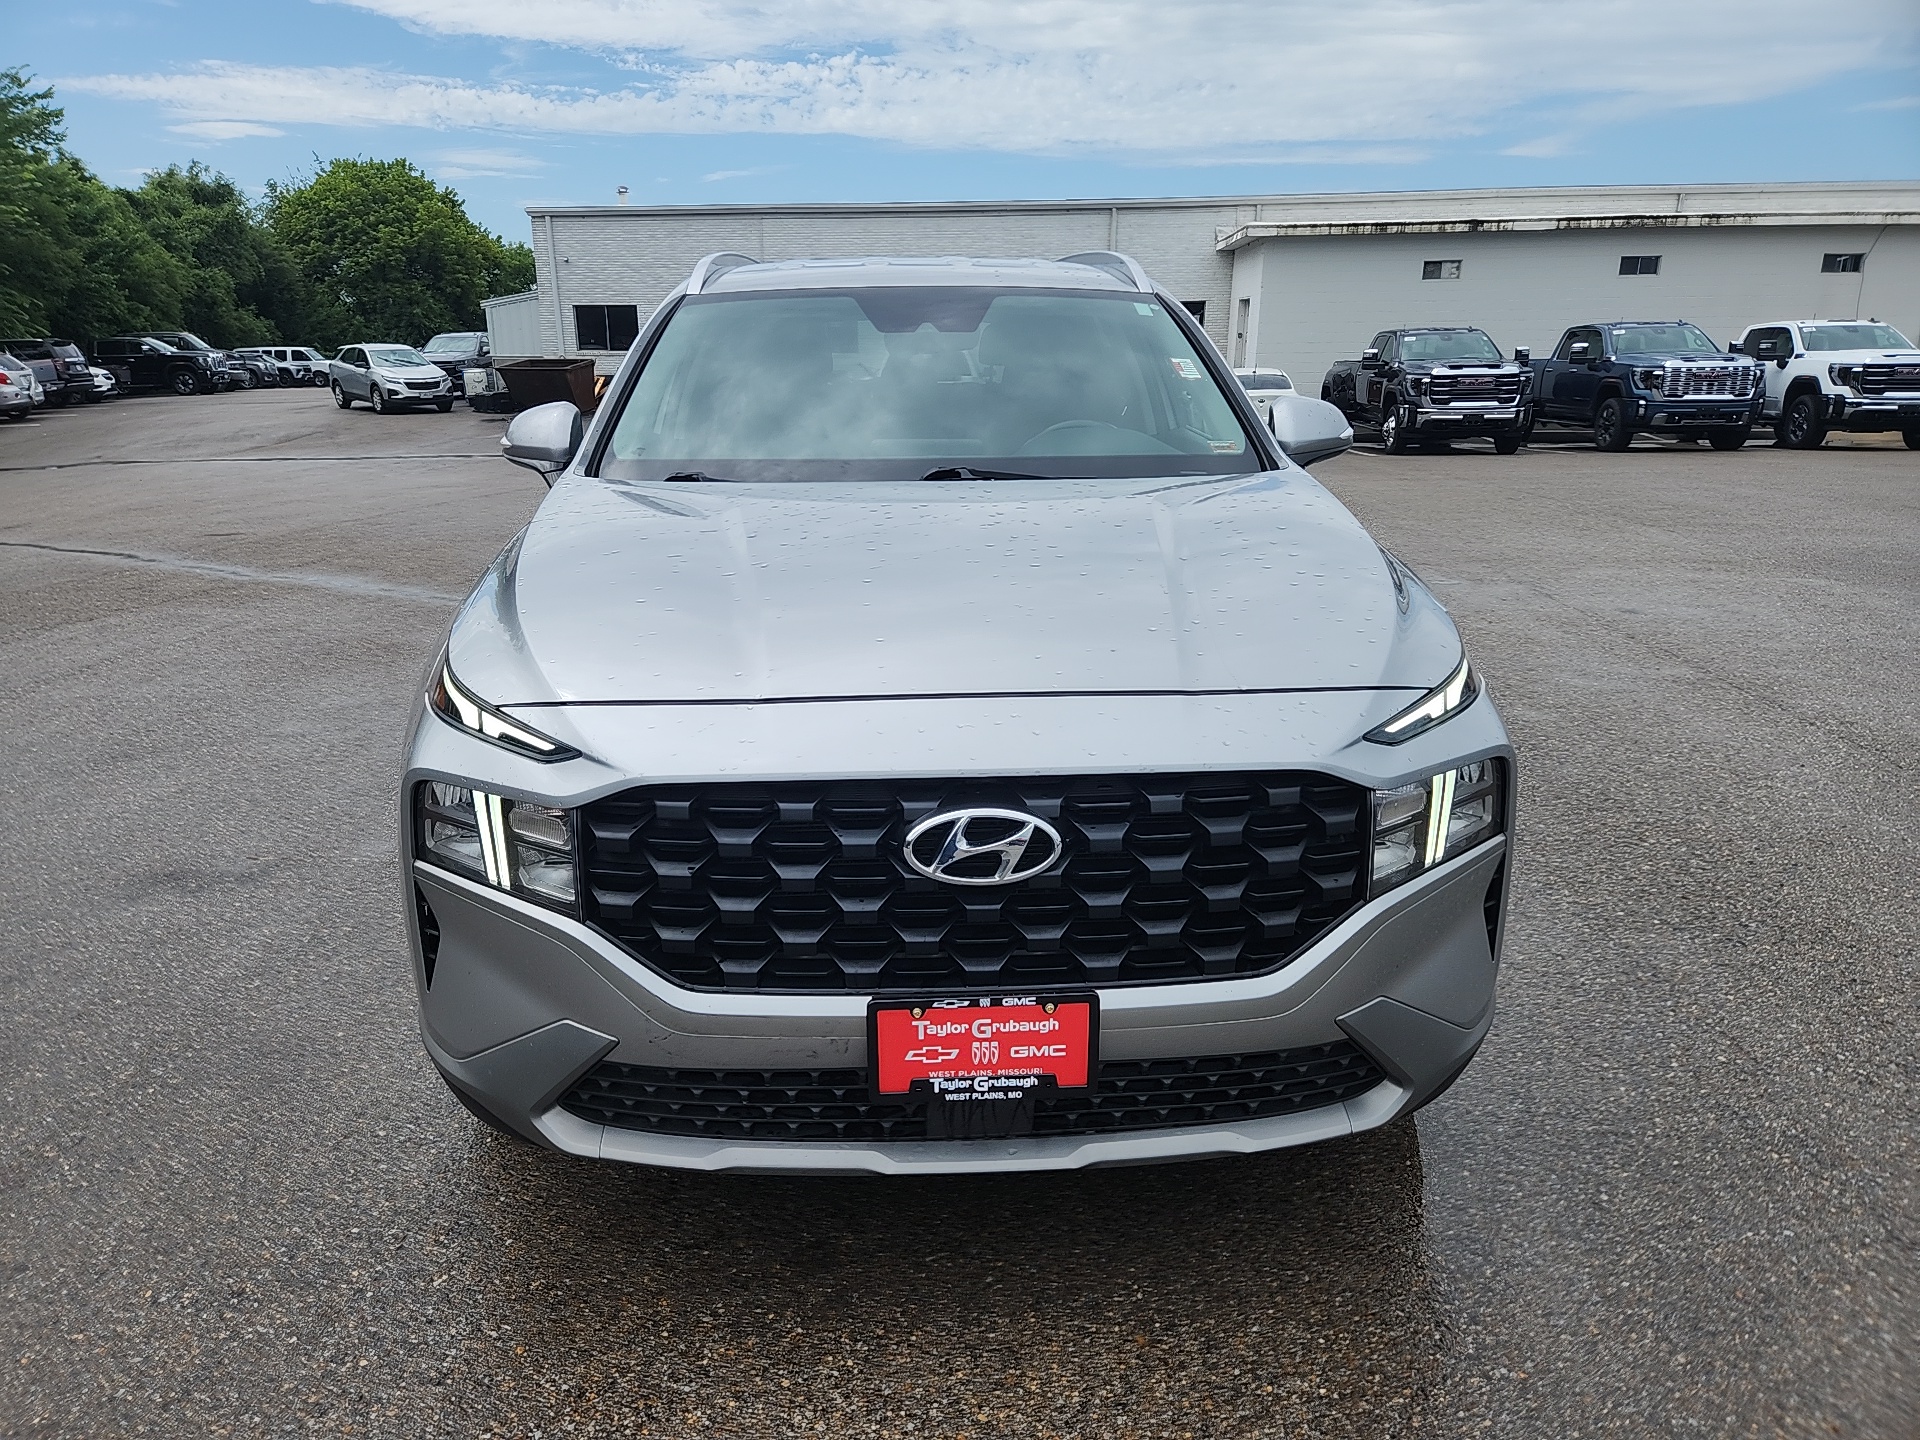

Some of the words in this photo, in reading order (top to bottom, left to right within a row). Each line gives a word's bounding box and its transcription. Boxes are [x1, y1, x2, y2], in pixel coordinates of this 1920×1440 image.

[1002, 997, 1036, 1006] GMC
[911, 1020, 969, 1040] Taylor
[972, 1018, 1059, 1039] Grubaugh
[1010, 1045, 1067, 1058] GMC
[928, 1070, 956, 1078] WEST
[997, 1067, 1043, 1076] MISSOURI
[929, 1077, 972, 1094] Taylor
[973, 1076, 1039, 1091] Grubaugh
[944, 1093, 971, 1101] WEST
[972, 1091, 1007, 1100] PLAINS,
[1008, 1091, 1023, 1099] MO
